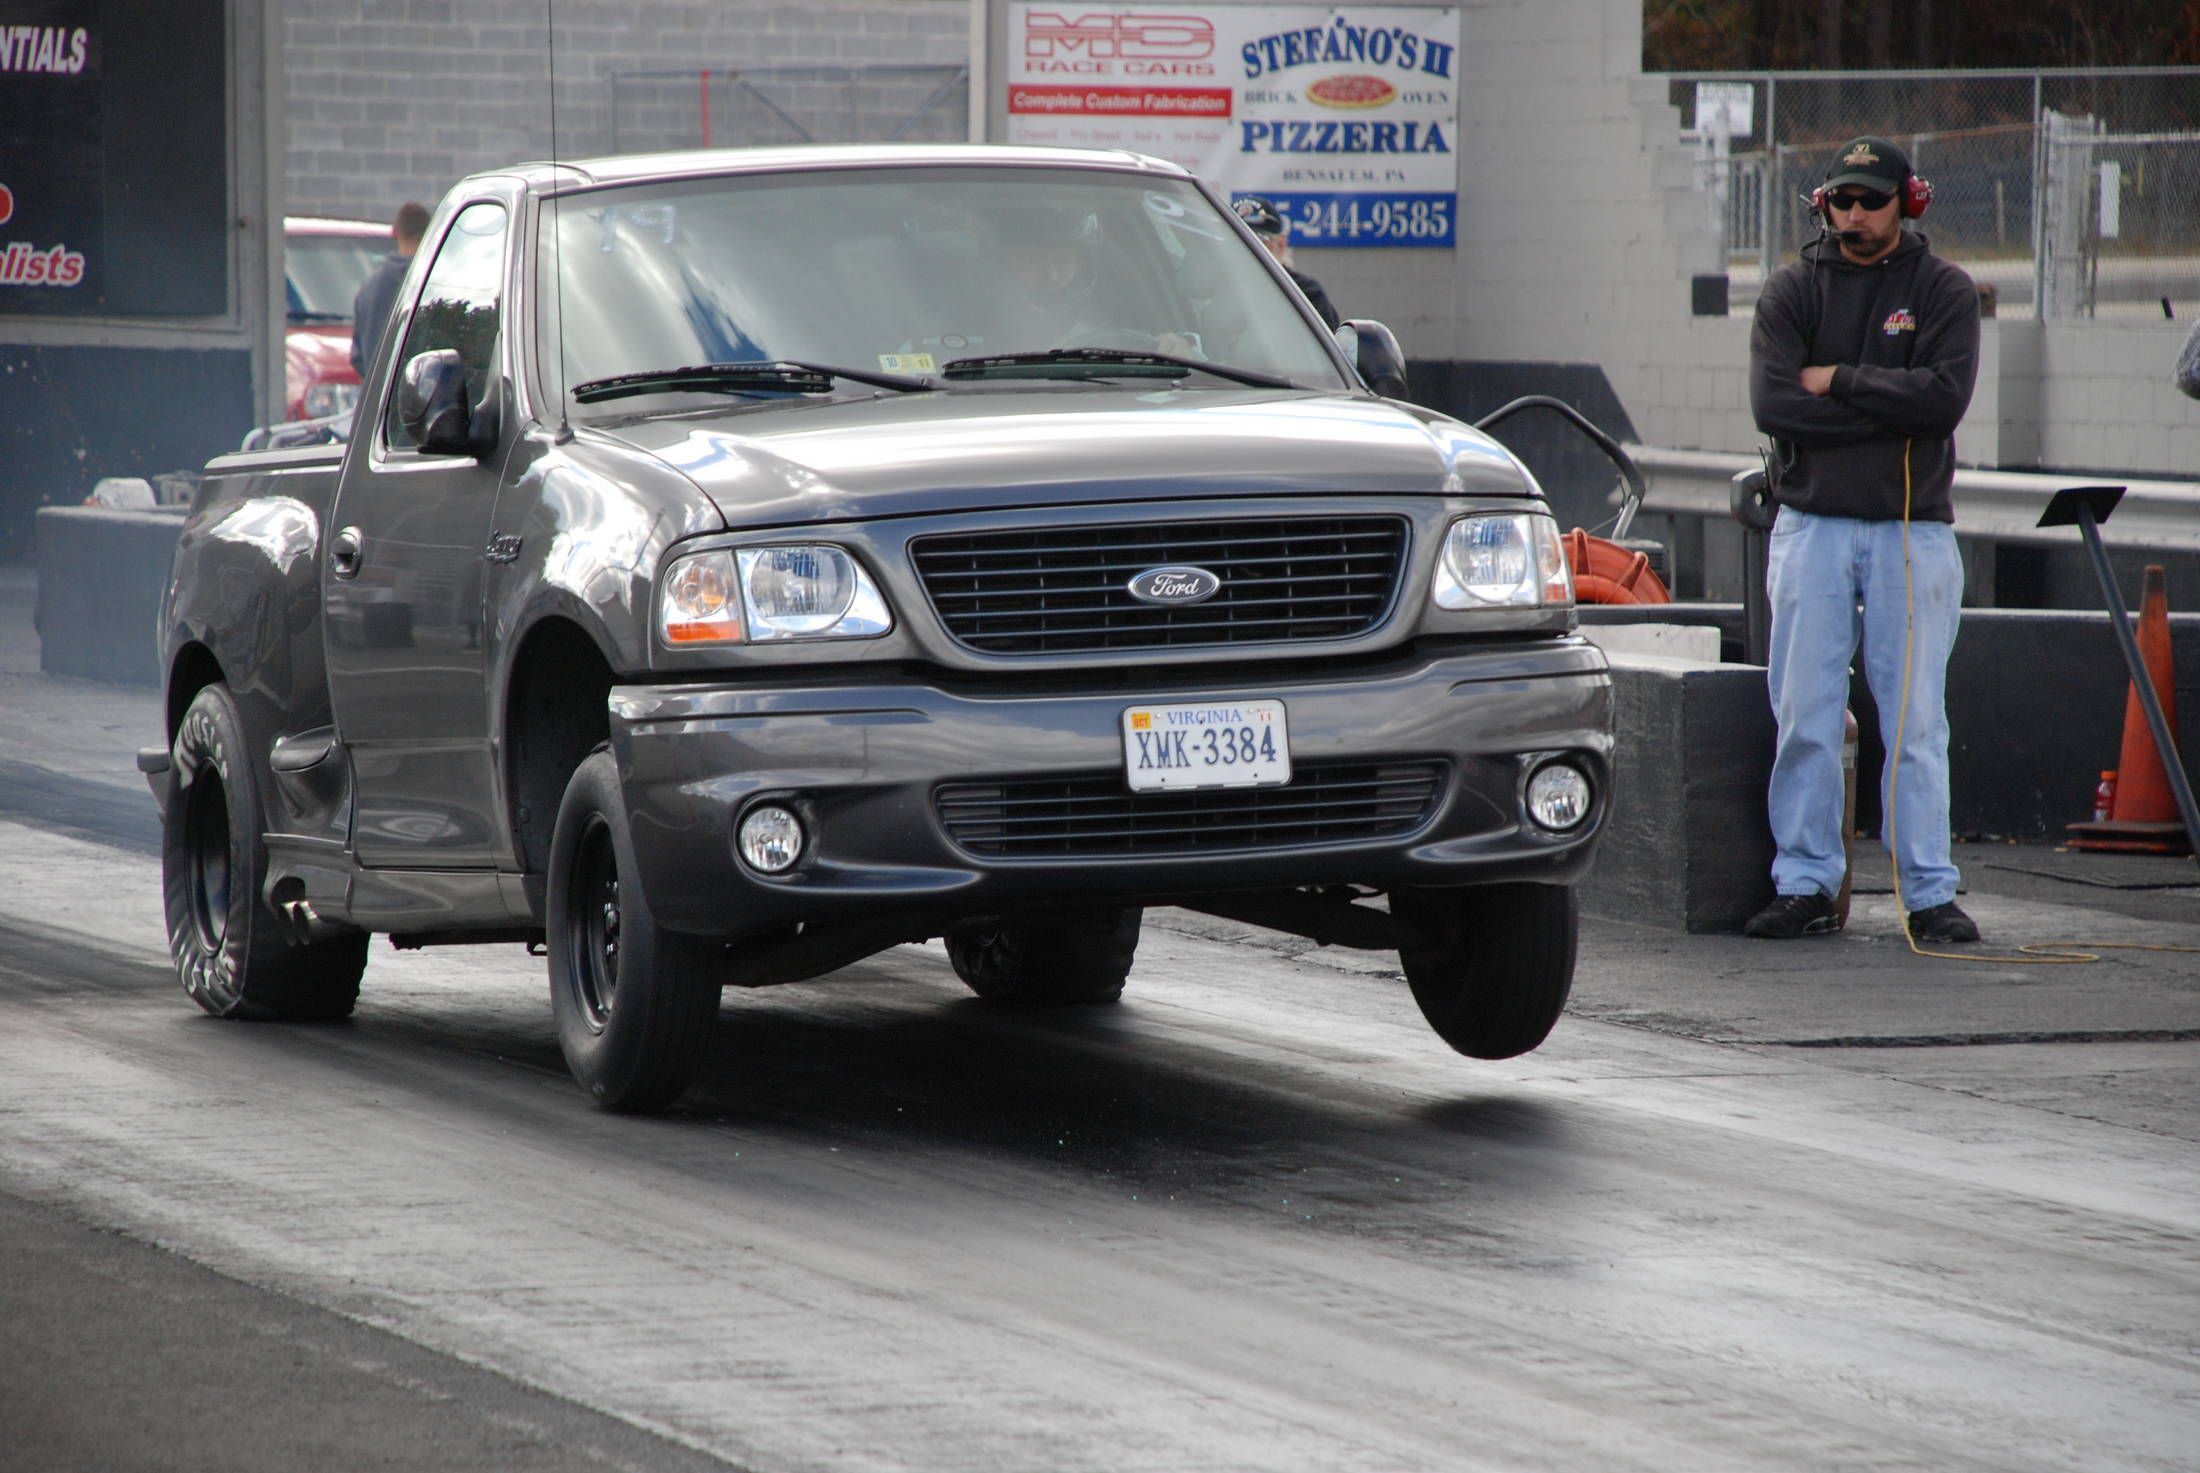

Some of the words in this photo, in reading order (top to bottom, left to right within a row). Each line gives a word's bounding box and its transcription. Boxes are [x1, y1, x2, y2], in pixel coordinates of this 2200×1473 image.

[1025, 60, 1112, 73] RACE
[1125, 62, 1215, 76] CARS
[1014, 91, 1083, 110] Complete
[1086, 92, 1139, 109] Custom
[1143, 93, 1226, 110] Fabrication
[1402, 91, 1449, 103] OVEN
[1241, 121, 1450, 152] PIZZERIA
[1385, 169, 1406, 181] PA
[1274, 200, 1449, 238] 5-244-9585
[0, 242, 84, 287] lists
[1151, 573, 1200, 597] Ford
[1167, 709, 1243, 725] VIRGINIA
[1135, 725, 1276, 769] XMK-3384
